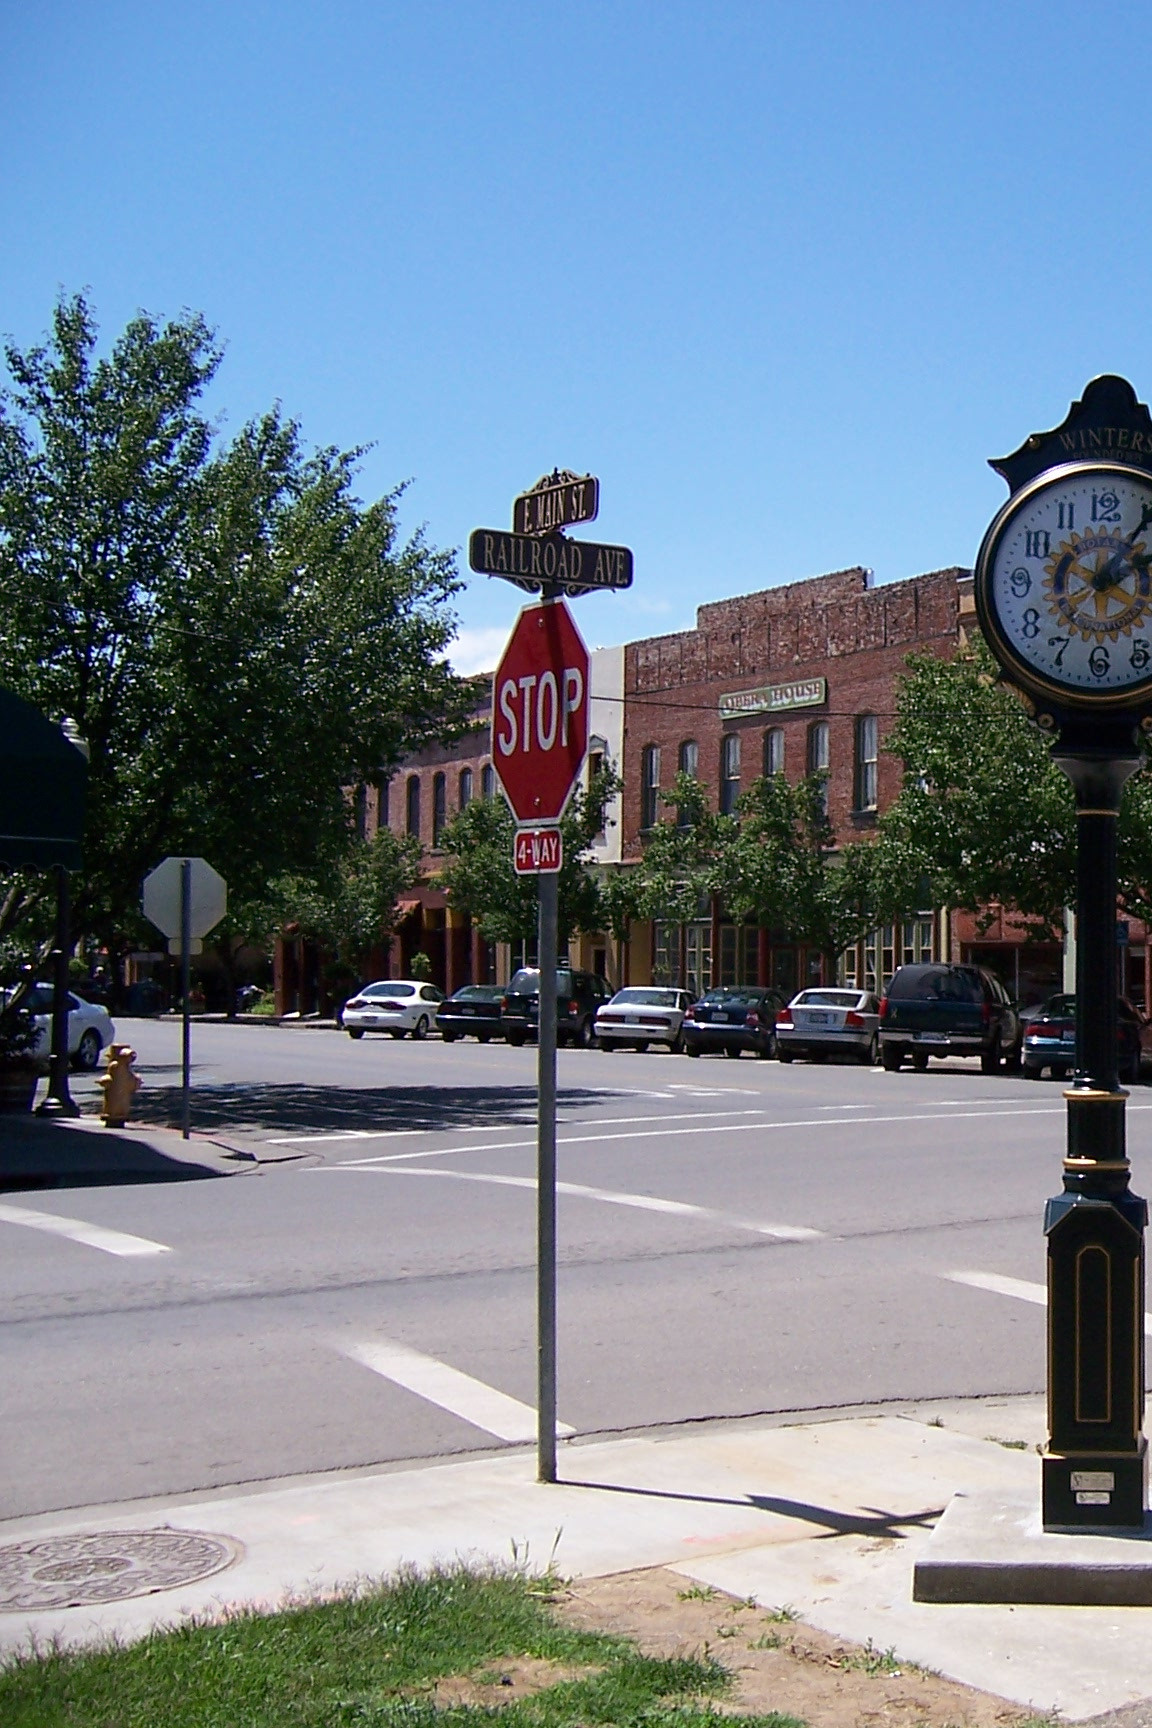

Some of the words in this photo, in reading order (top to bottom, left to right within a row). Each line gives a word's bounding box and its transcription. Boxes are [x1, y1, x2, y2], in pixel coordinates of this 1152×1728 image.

[523, 499, 533, 533] E.
[536, 488, 567, 530] MAIN
[1057, 501, 1075, 530] 11
[1089, 492, 1122, 523] 12
[484, 534, 583, 578] RAILROAD
[593, 550, 629, 584] AVE.
[1025, 530, 1051, 559] 10
[1010, 567, 1033, 598] 9
[1022, 608, 1040, 639] 8
[1048, 636, 1070, 667] 7
[1088, 646, 1110, 678] 6
[1129, 639, 1151, 669] 5
[771, 683, 820, 705] HOUSE
[498, 667, 583, 757] STOP
[517, 837, 558, 864] 4-WAY
